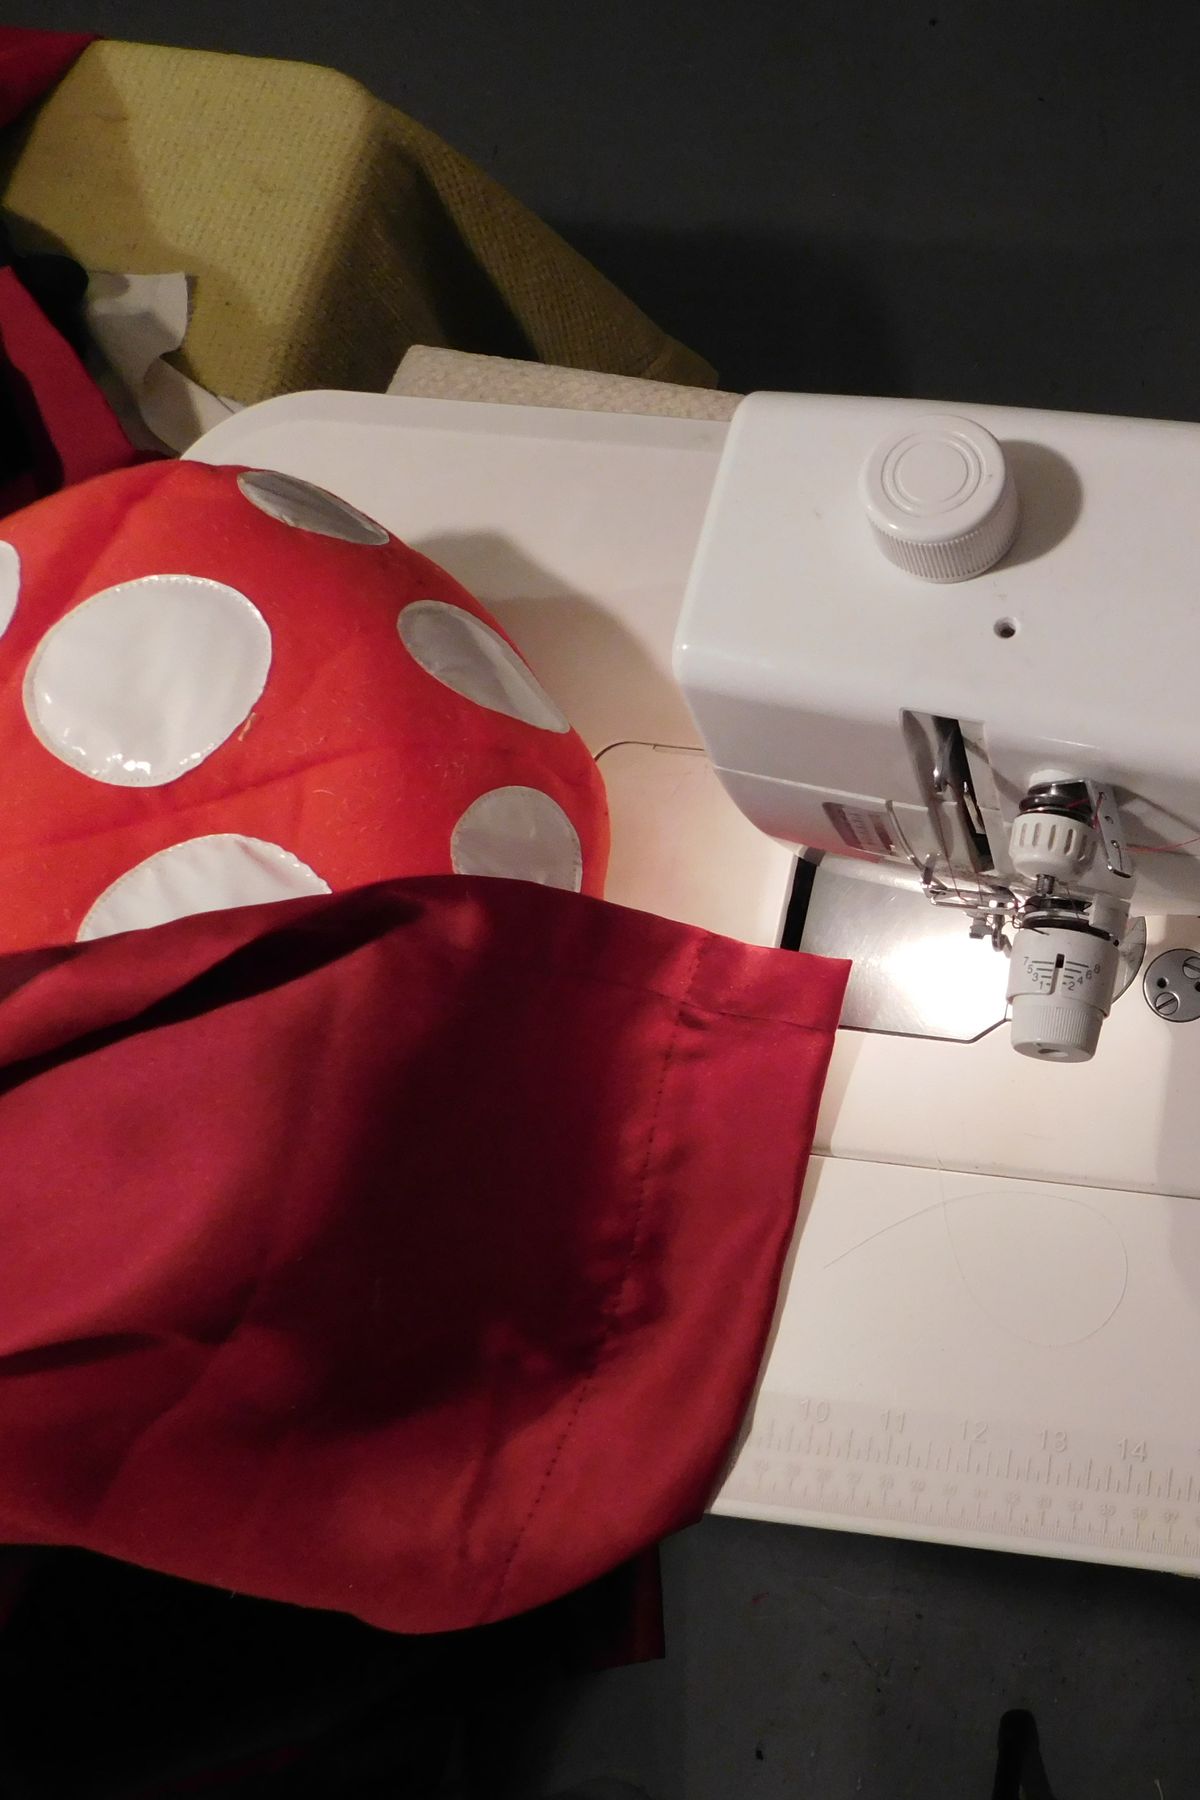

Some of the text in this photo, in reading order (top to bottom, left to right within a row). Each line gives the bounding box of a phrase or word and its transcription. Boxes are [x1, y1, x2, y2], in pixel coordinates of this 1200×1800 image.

[1023, 956, 1029, 966] 7
[1027, 964, 1034, 974] 5
[1093, 963, 1101, 974] 8
[1032, 972, 1039, 982] 3
[1085, 969, 1093, 980] 6
[1077, 976, 1084, 985] 4
[1068, 981, 1075, 991] 2
[800, 1398, 831, 1424] 10
[880, 1408, 906, 1434] 11
[960, 1419, 989, 1444] 12
[1040, 1429, 1068, 1453] 13
[1118, 1437, 1148, 1463] 14
